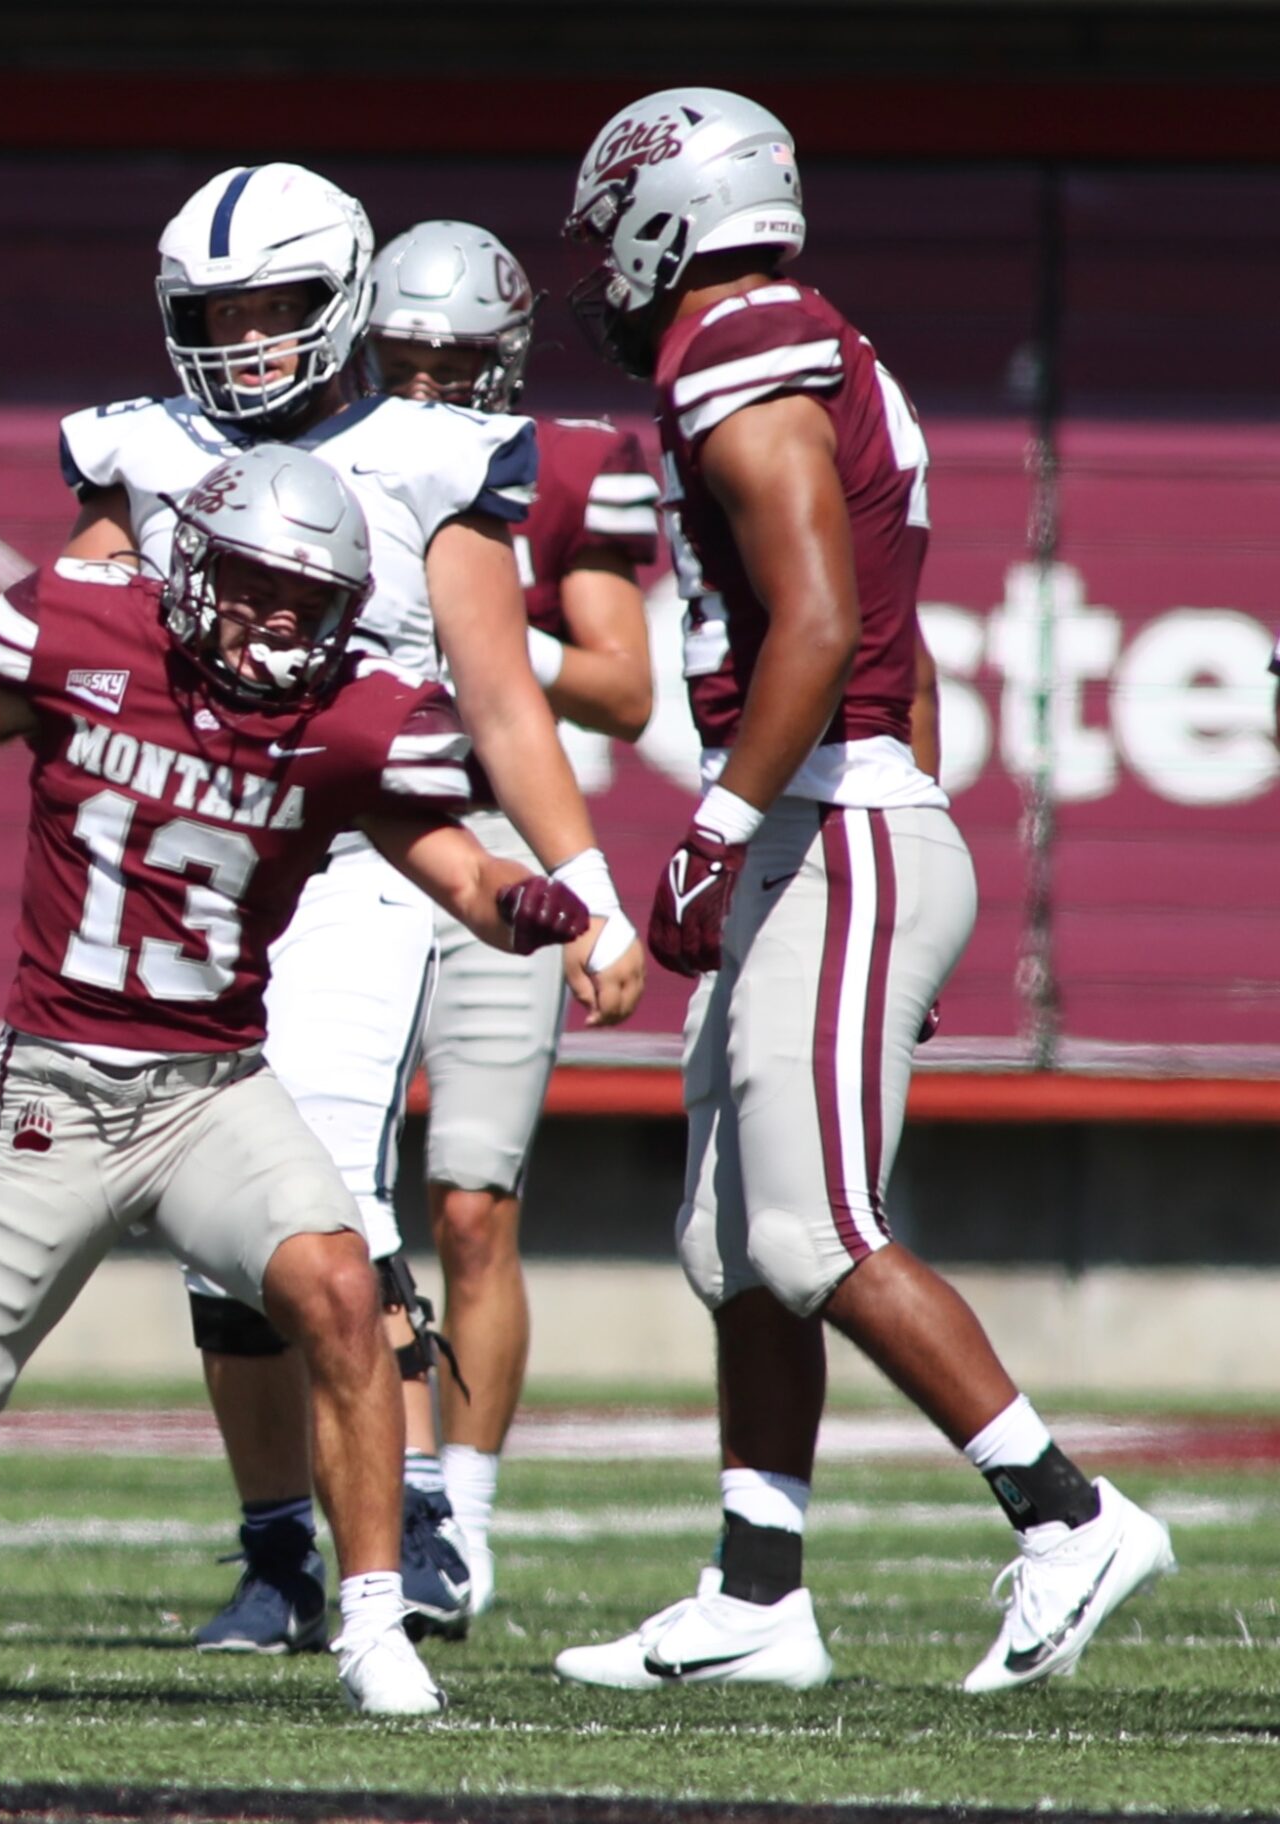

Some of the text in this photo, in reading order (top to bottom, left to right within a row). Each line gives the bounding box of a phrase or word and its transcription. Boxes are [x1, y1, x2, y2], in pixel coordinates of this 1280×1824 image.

[594, 114, 682, 186] Griz
[66, 713, 306, 830] MONTANA
[60, 788, 260, 1002] 13
